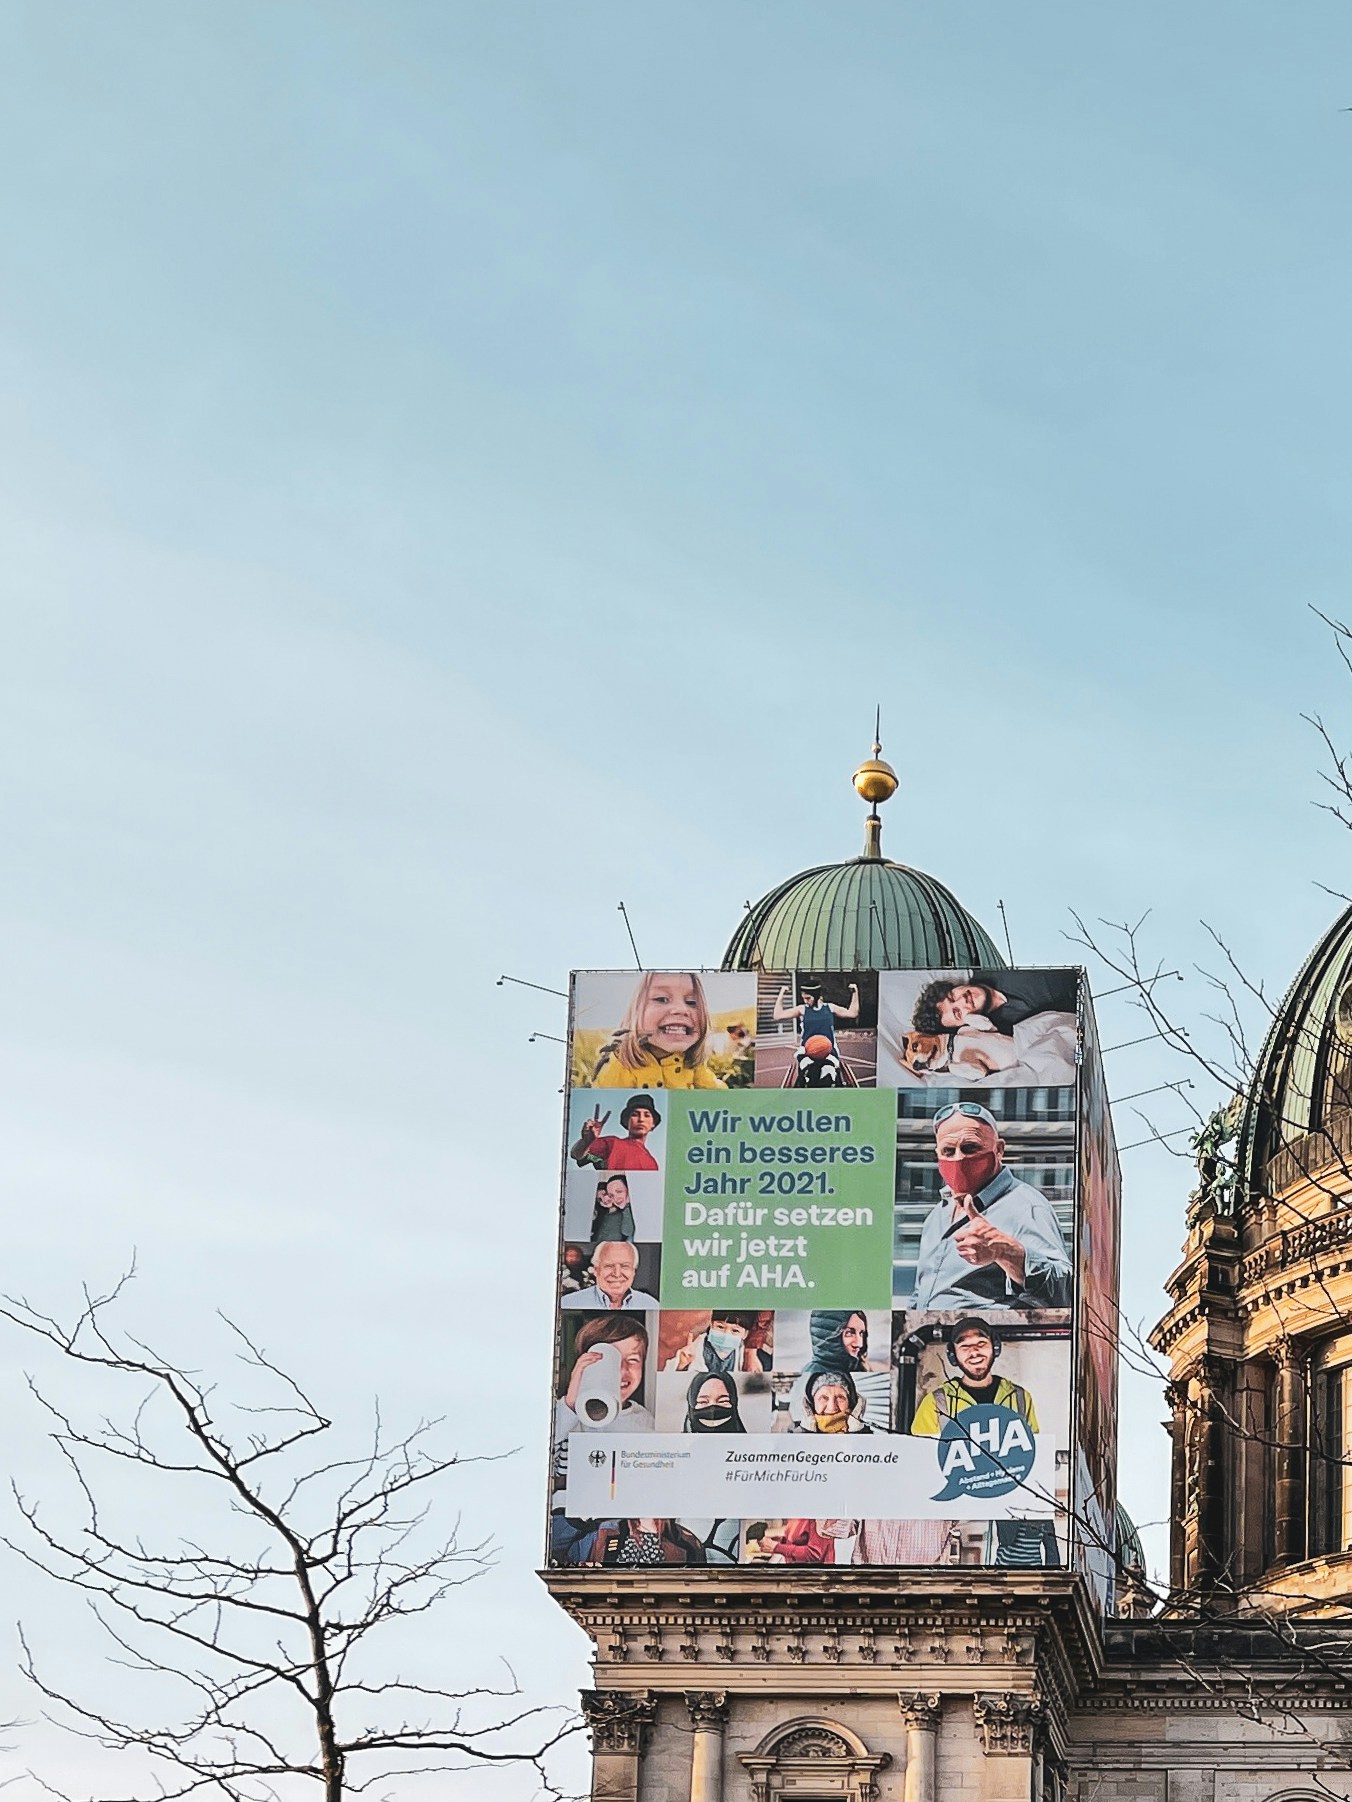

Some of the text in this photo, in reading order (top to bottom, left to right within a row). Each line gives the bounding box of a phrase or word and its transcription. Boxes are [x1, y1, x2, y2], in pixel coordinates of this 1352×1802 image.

[688, 1109, 851, 1133] Wir wollen
[687, 1139, 875, 1164] ein besseres
[684, 1171, 835, 1195] Jahr 2021.
[684, 1201, 873, 1226] Dafür setzen
[683, 1231, 808, 1263] wir jetzt
[681, 1263, 816, 1289] auf AHA.
[725, 1450, 899, 1466] ZusammenGegenCorona.de
[943, 1417, 1033, 1478] AHA
[632, 1459, 675, 1469] Gesundheit
[725, 1469, 828, 1483] #FürMichFürUns
